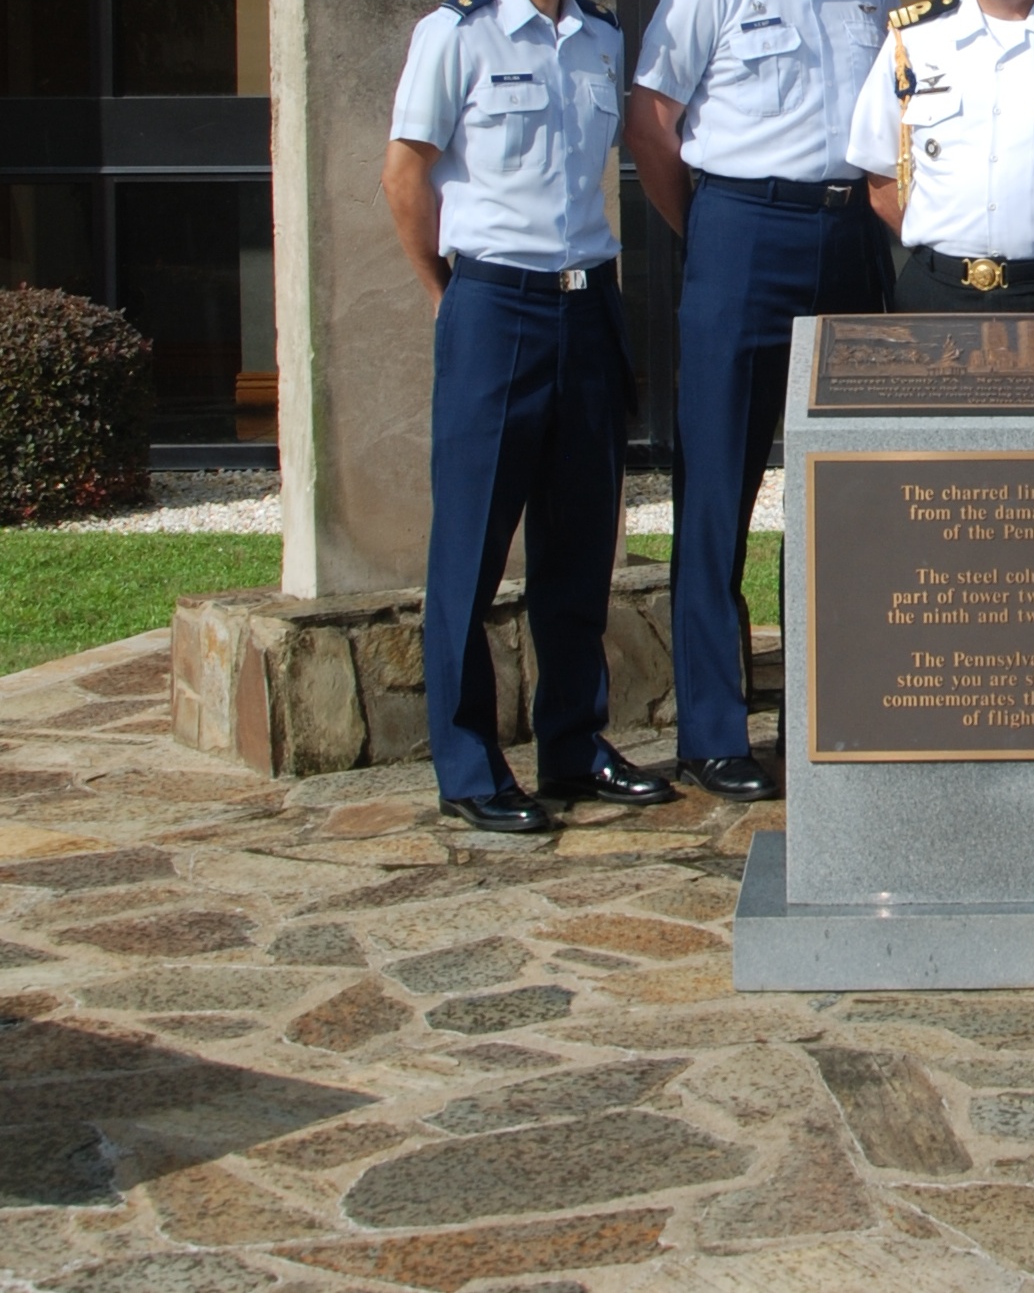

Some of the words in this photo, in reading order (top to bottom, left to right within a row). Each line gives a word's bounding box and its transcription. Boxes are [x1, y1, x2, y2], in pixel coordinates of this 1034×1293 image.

[901, 485, 935, 501] The
[942, 485, 1008, 501] charred
[910, 505, 951, 521] from
[961, 505, 988, 521] the
[943, 525, 960, 540] of
[968, 525, 995, 540] the
[916, 568, 951, 585] The
[957, 568, 997, 584] steel
[893, 590, 928, 606] part
[937, 588, 954, 605] of
[962, 589, 1010, 604] tower
[888, 609, 914, 624] the
[923, 608, 969, 624] ninth
[978, 608, 1009, 624] and
[912, 652, 945, 668] The
[897, 673, 943, 688] stone
[952, 675, 982, 691] you
[990, 674, 1017, 687] are
[883, 691, 1015, 708] commemorates
[963, 711, 980, 726] of
